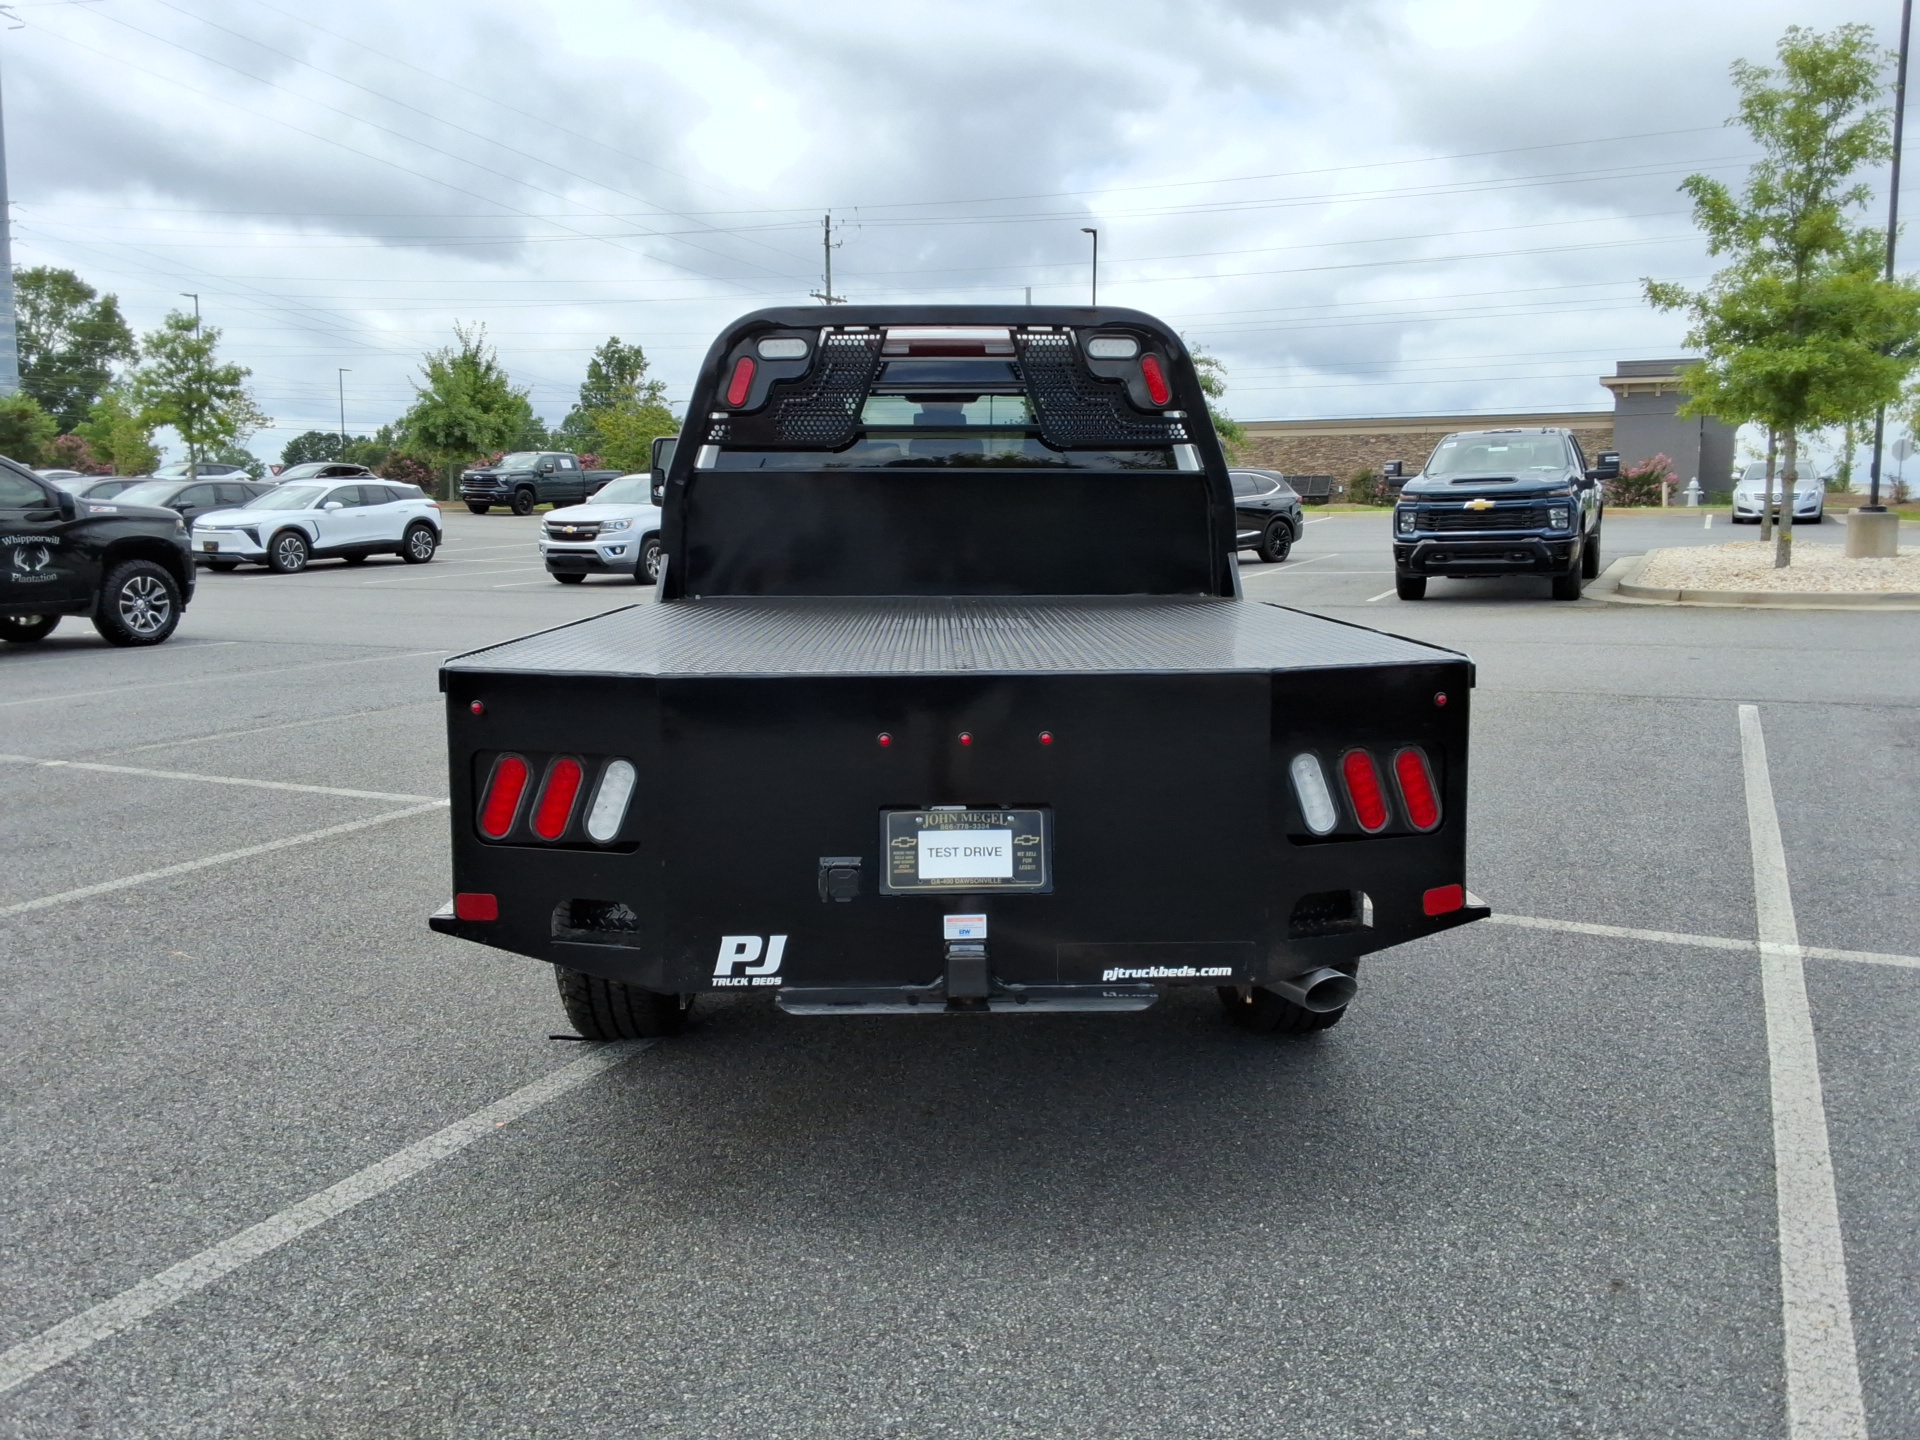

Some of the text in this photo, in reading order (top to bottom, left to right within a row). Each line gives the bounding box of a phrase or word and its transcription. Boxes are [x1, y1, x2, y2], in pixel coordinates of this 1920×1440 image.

[2, 535, 60, 546] Whippoorwill
[11, 572, 57, 583] Plantation
[923, 813, 1008, 829] JOHN MEGEL
[927, 847, 959, 858] TEST
[964, 846, 1002, 857] DRIVE
[713, 935, 787, 976] PJ
[1102, 965, 1232, 981] pjtruckbeds.com
[712, 976, 782, 987] TRUCK BEDS
